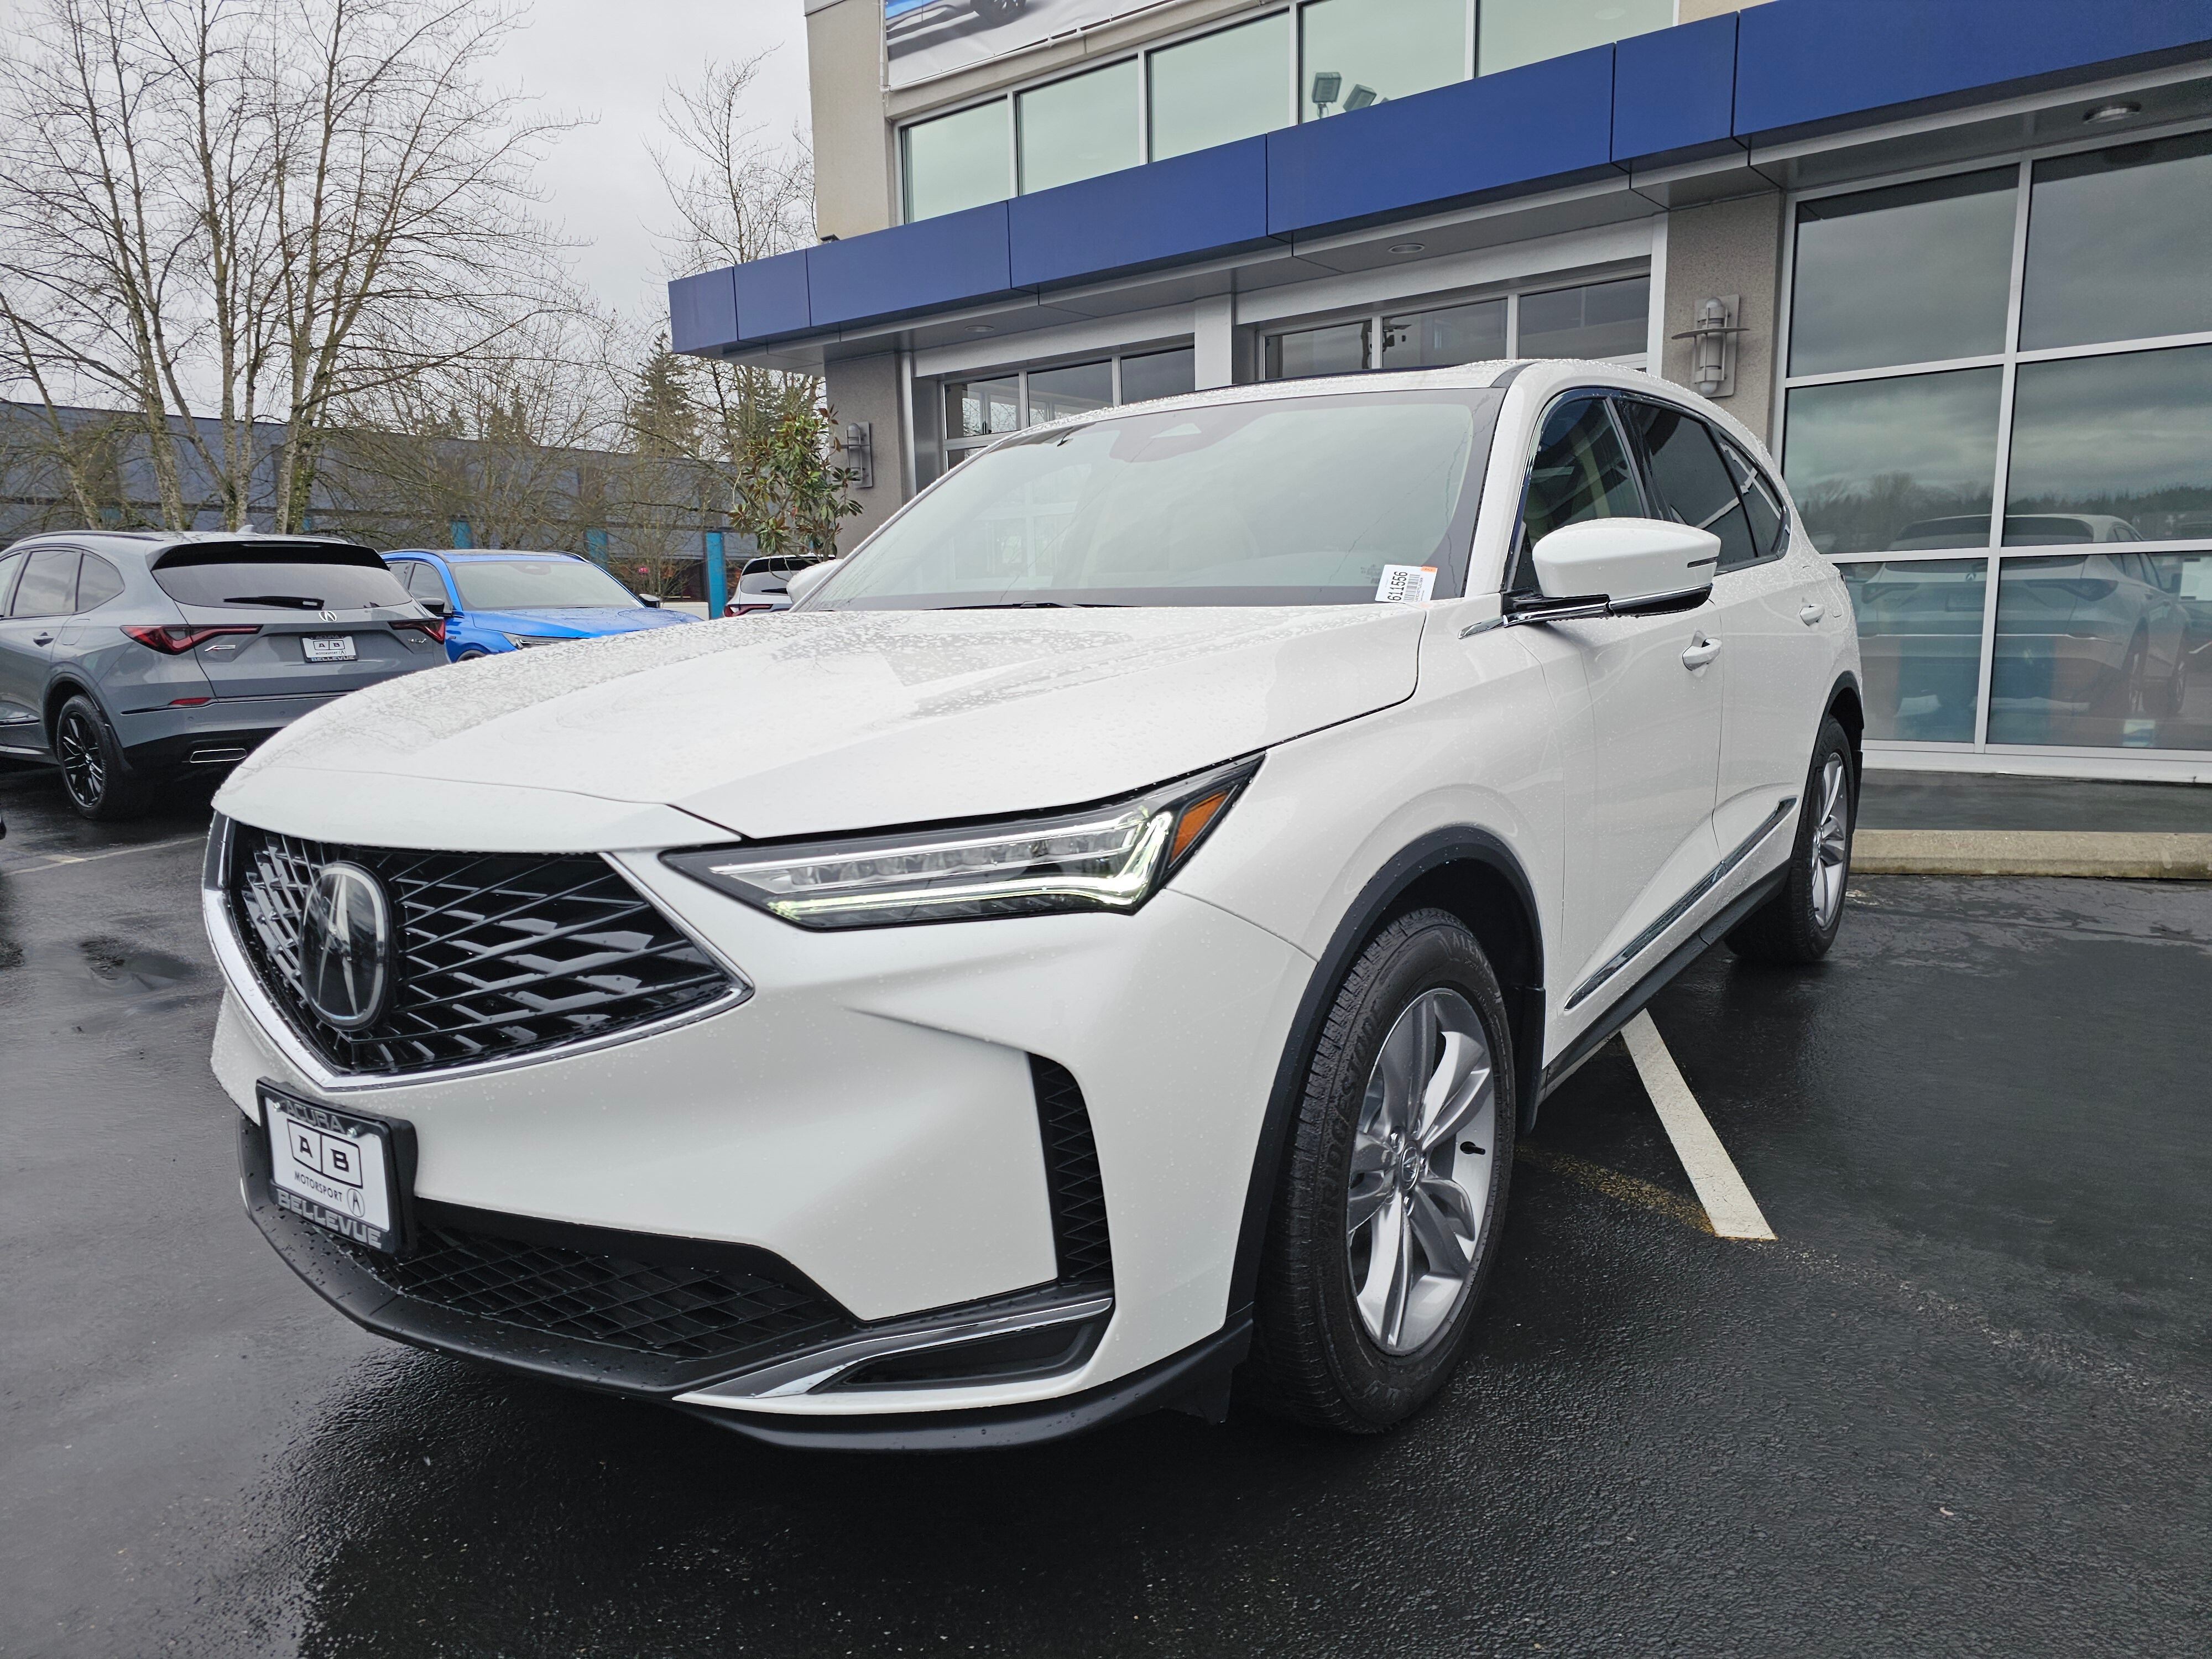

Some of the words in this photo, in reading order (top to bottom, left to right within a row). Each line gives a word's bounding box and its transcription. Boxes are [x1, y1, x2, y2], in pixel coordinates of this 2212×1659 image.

[1387, 571, 1408, 601] 611556
[286, 1100, 346, 1133] ACURA
[299, 1135, 313, 1159] A
[330, 1149, 349, 1172] B
[294, 1171, 343, 1201] MOTORSPORT
[278, 1190, 382, 1249] BELLEVUE
